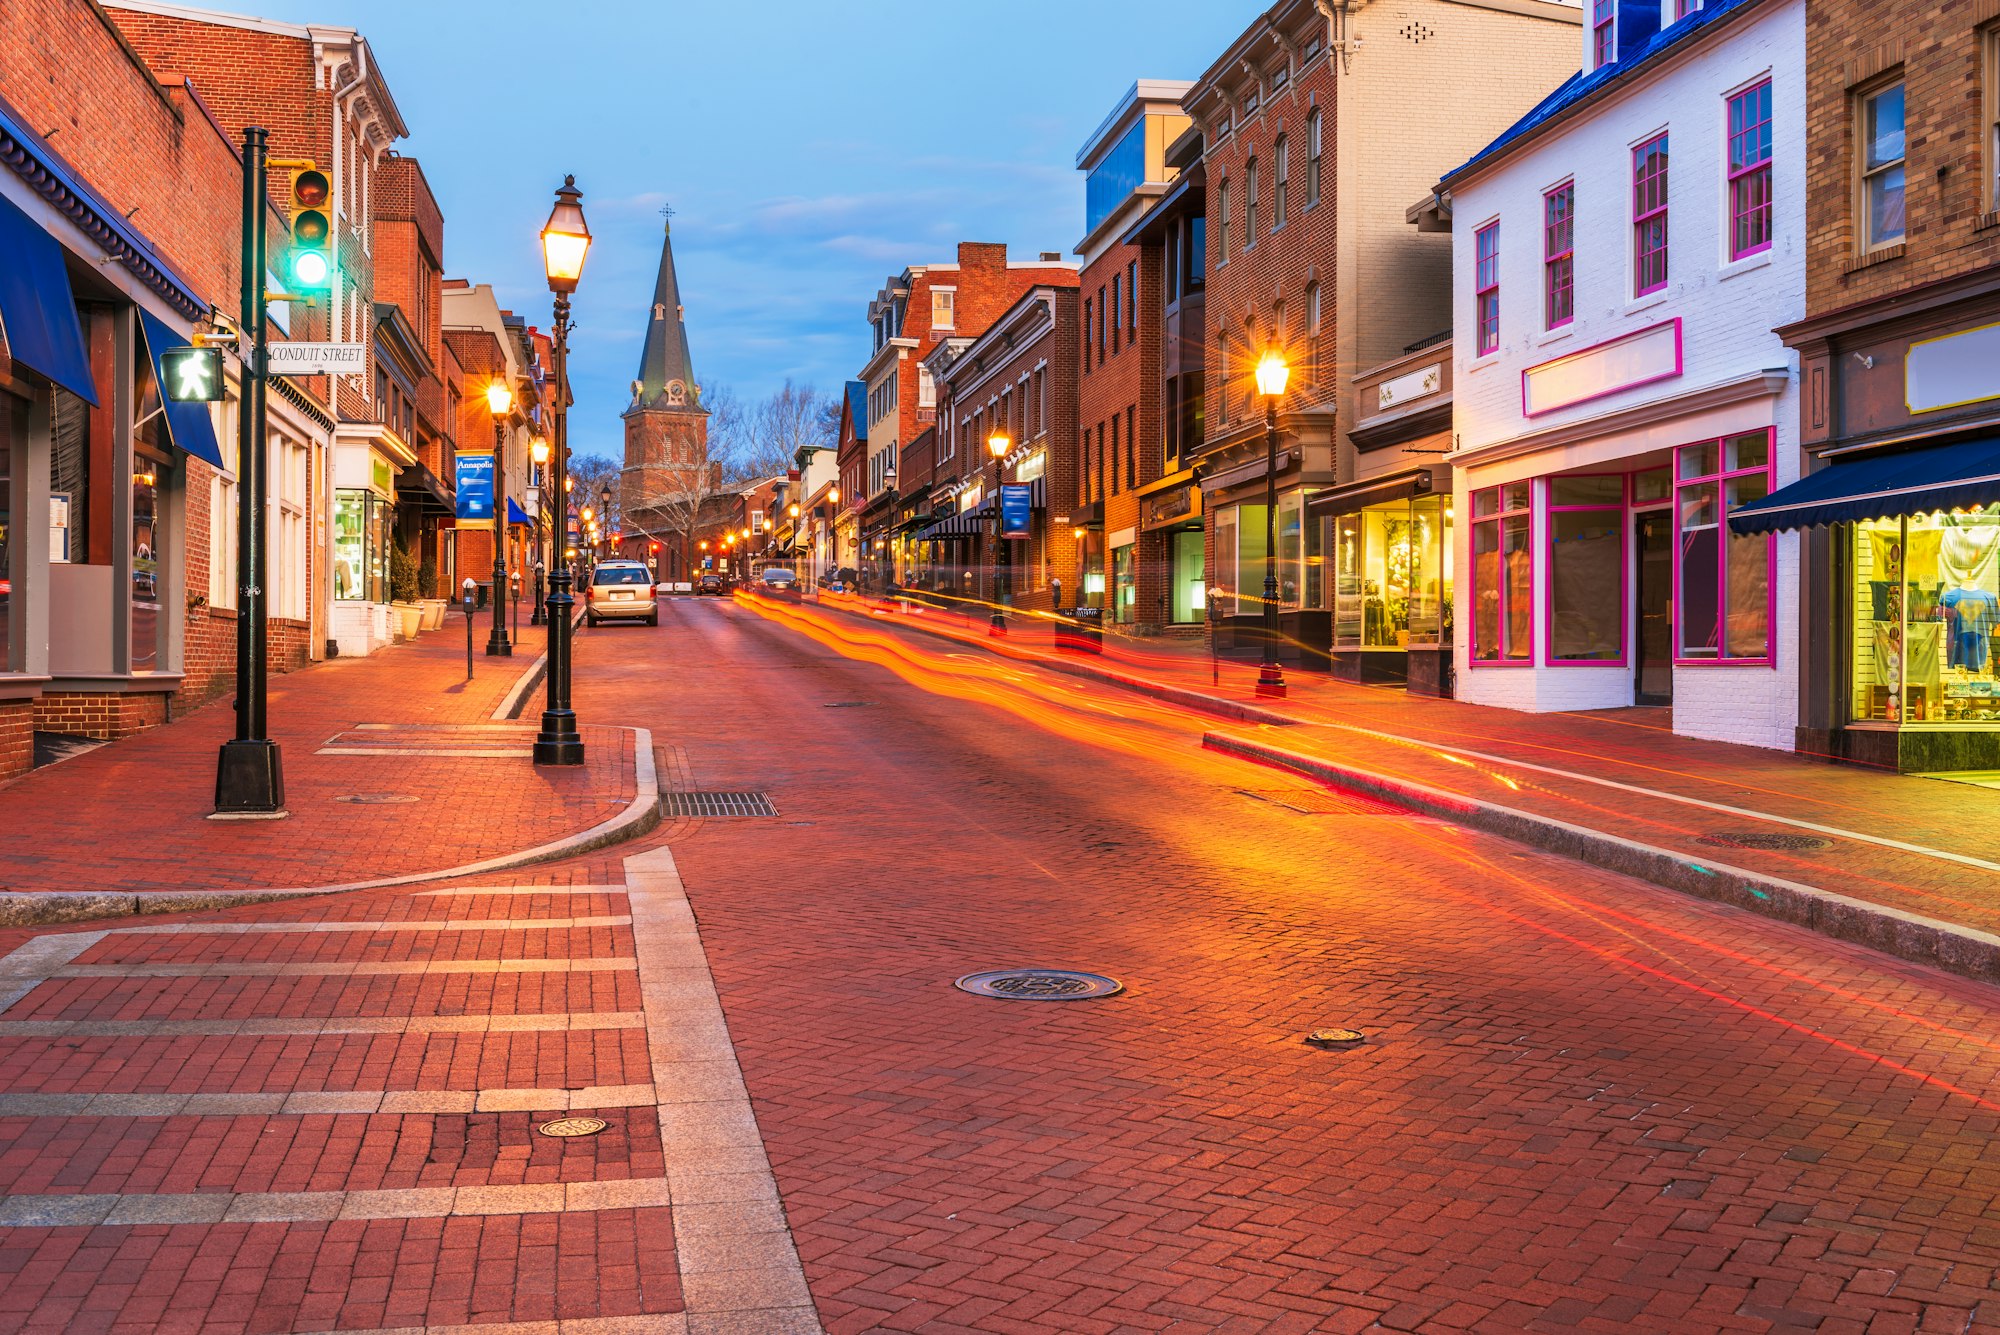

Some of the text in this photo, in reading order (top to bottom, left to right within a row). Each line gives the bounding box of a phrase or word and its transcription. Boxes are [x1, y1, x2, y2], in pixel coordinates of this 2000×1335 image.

[272, 347, 362, 362] CONDUIT STREET
[457, 460, 493, 471] Annapolis
